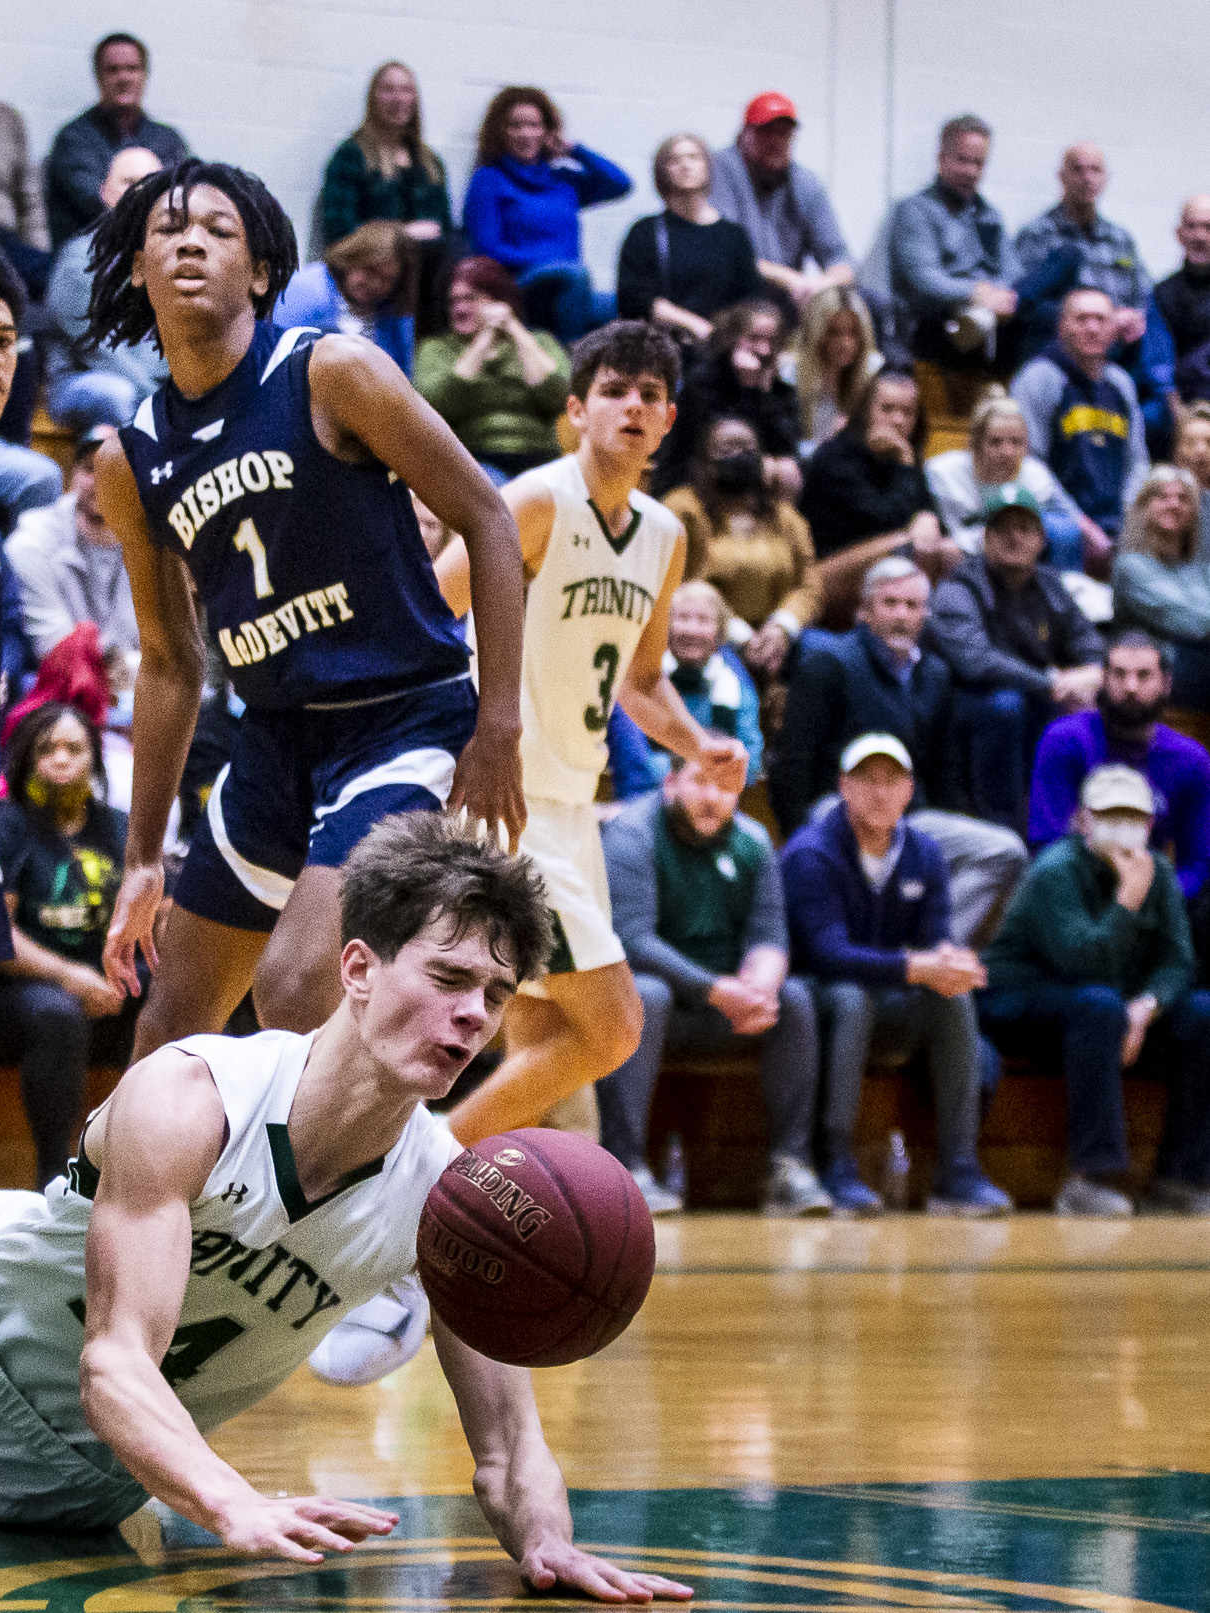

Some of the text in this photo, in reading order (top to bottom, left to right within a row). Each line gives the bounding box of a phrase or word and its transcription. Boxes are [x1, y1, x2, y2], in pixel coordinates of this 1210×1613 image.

[168, 450, 294, 550] BISHOP
[232, 517, 274, 599] 1
[560, 576, 656, 625] TRINIT
[584, 642, 620, 732] 3
[448, 1148, 553, 1242] PALDING
